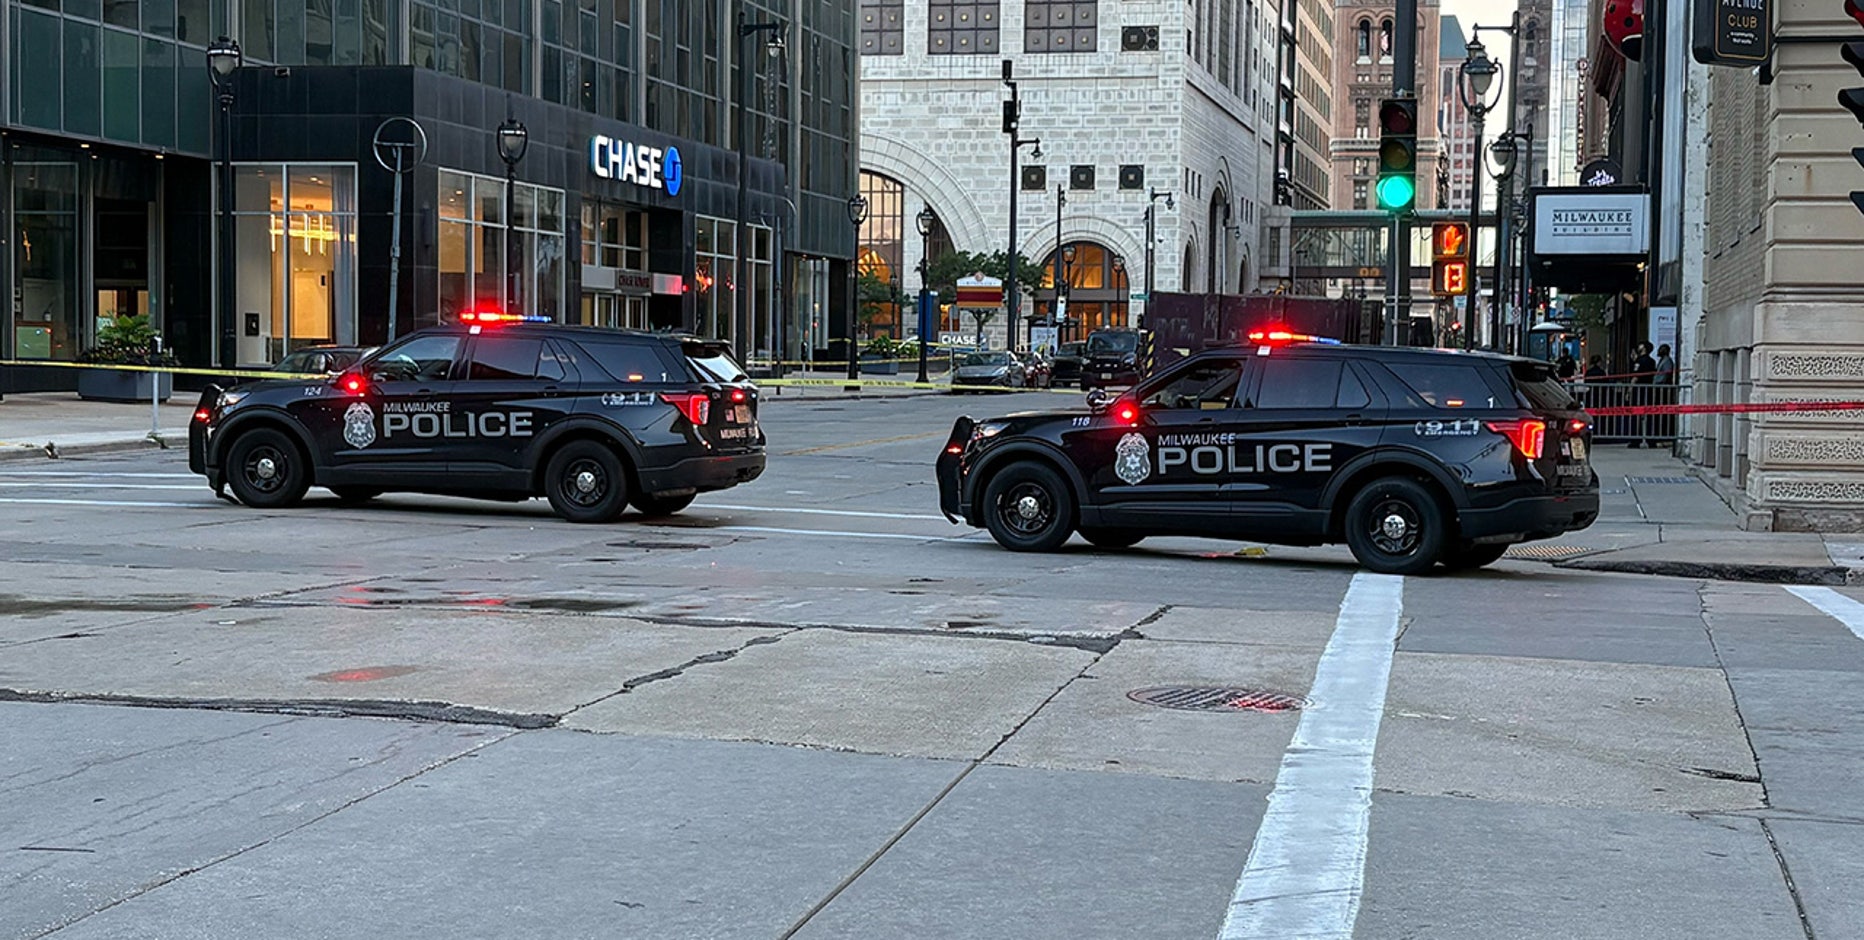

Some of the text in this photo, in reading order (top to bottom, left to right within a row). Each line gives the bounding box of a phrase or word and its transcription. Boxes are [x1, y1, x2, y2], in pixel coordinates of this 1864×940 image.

[1727, 14, 1758, 29] CLUB
[593, 134, 662, 189] CHASE
[1552, 212, 1632, 223] MILWAUKEE
[304, 386, 323, 396] 124
[383, 402, 451, 413] MILWAUKEE
[383, 412, 533, 438] POLICE
[1158, 433, 1236, 446] MILWAUKEE
[1158, 444, 1332, 475] POLICE
